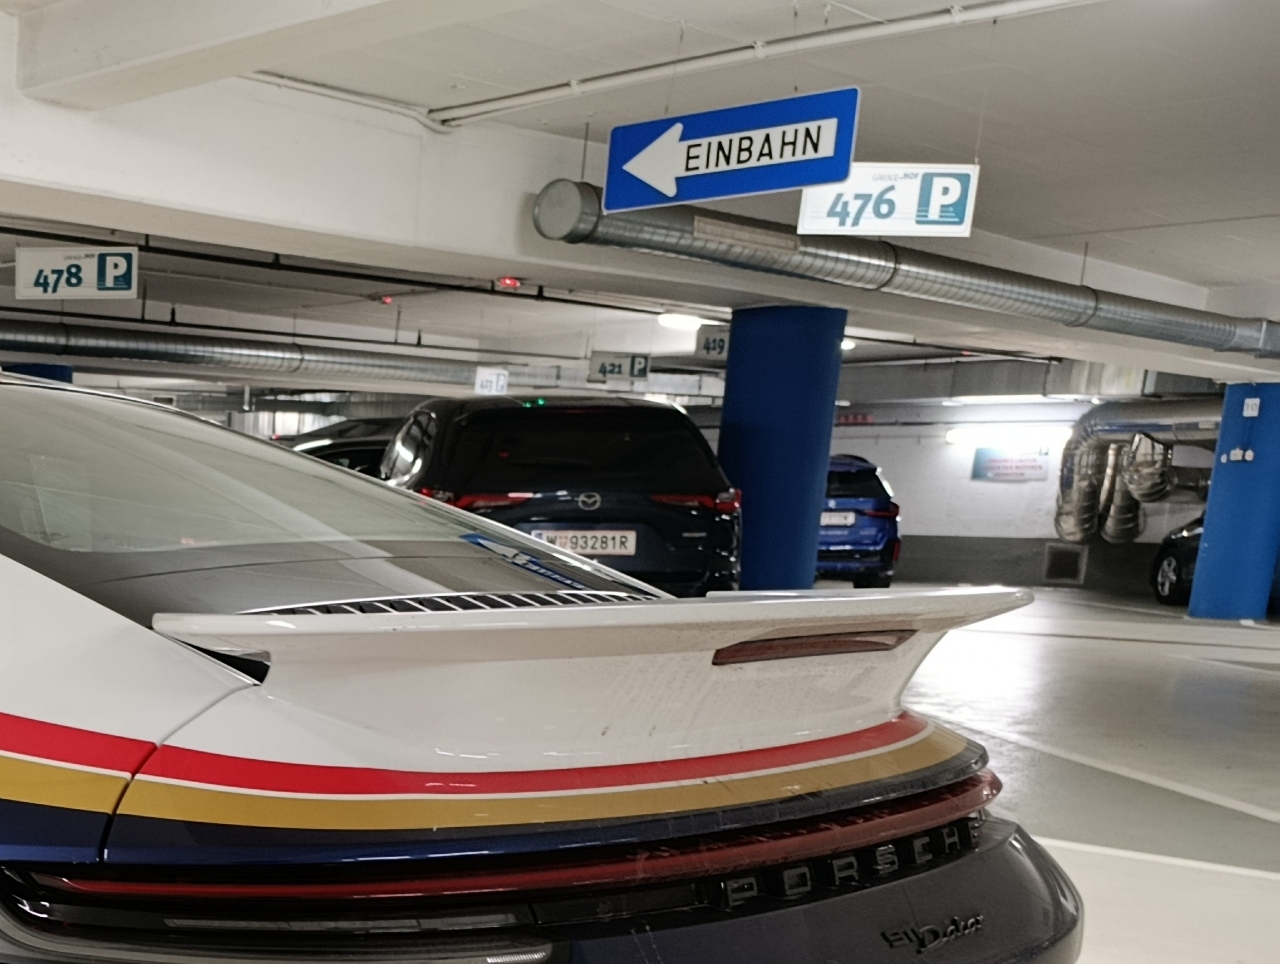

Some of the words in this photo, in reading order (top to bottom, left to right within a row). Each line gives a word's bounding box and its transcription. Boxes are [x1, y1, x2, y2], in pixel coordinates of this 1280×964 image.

[684, 124, 822, 173] EINBAHN
[826, 185, 896, 228] 476
[927, 175, 962, 220] P
[33, 263, 83, 294] 478
[105, 256, 128, 288] P
[703, 336, 725, 355] 419
[598, 362, 623, 377] 421
[633, 356, 645, 376] P
[571, 535, 629, 550] 93281R
[721, 819, 980, 910] PORSCHE
